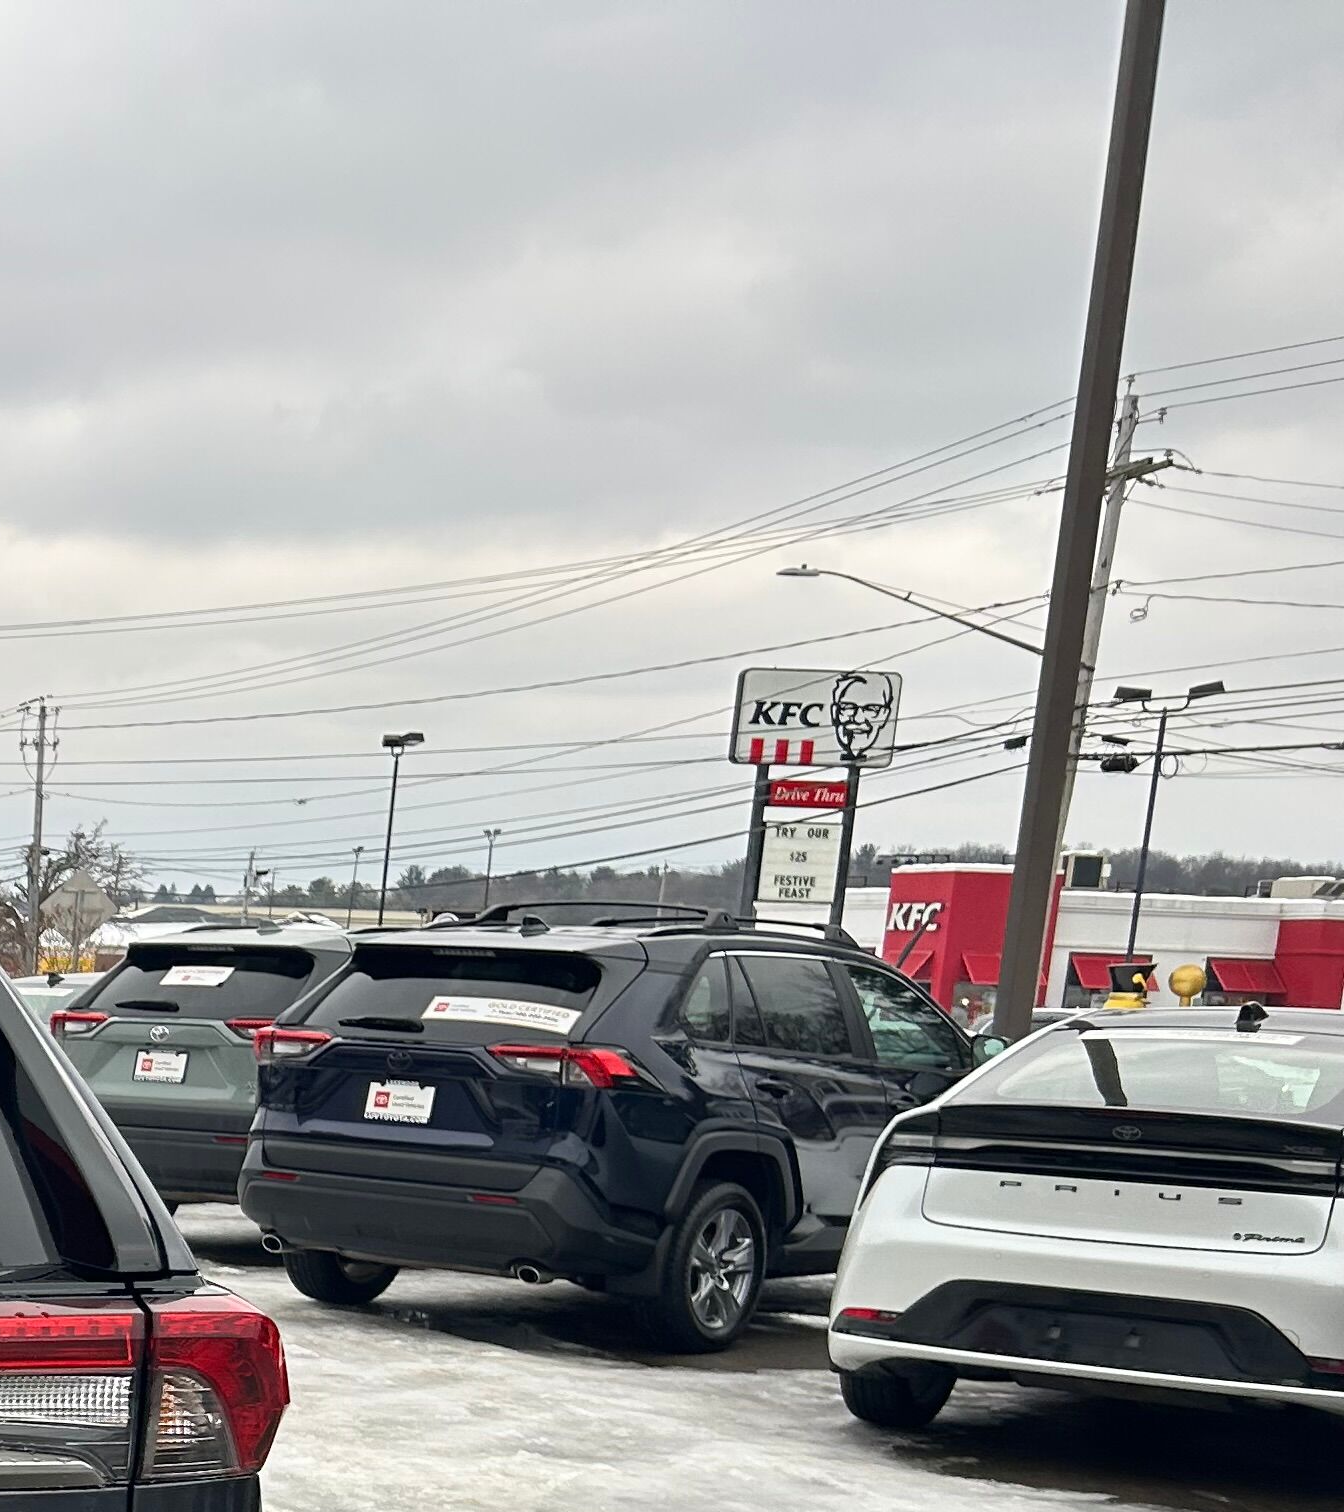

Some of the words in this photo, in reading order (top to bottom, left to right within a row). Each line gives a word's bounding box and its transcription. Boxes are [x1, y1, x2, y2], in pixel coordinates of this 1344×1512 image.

[749, 700, 824, 727] KFC
[774, 786, 810, 801] Drive
[814, 787, 846, 802] Thru
[776, 826, 797, 838] TRY
[807, 827, 830, 839] OUR
[789, 851, 808, 862] $25
[774, 874, 816, 887] FESTIVE
[778, 887, 811, 898] FEAST
[886, 902, 943, 931] KFC
[999, 1180, 1243, 1205] PRIUS
